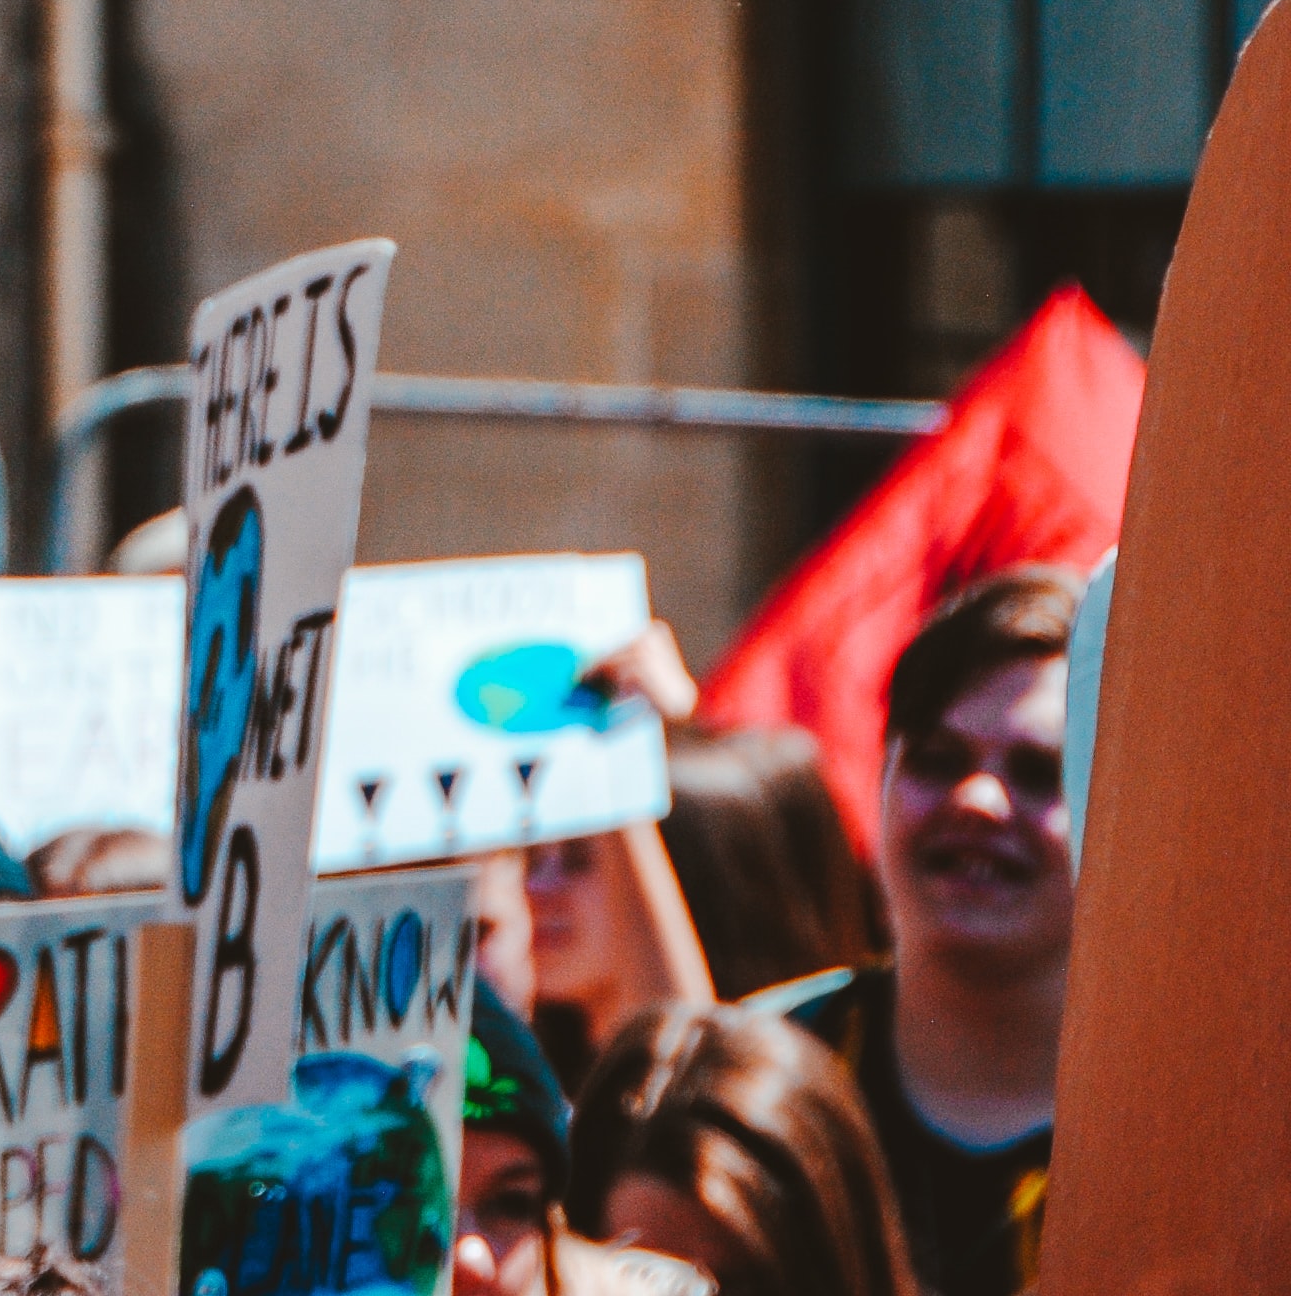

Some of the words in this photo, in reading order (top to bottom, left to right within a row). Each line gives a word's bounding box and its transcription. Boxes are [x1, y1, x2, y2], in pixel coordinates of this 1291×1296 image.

[284, 263, 369, 457] IS
[199, 825, 258, 1098] B
[298, 907, 475, 1057] KNOW
